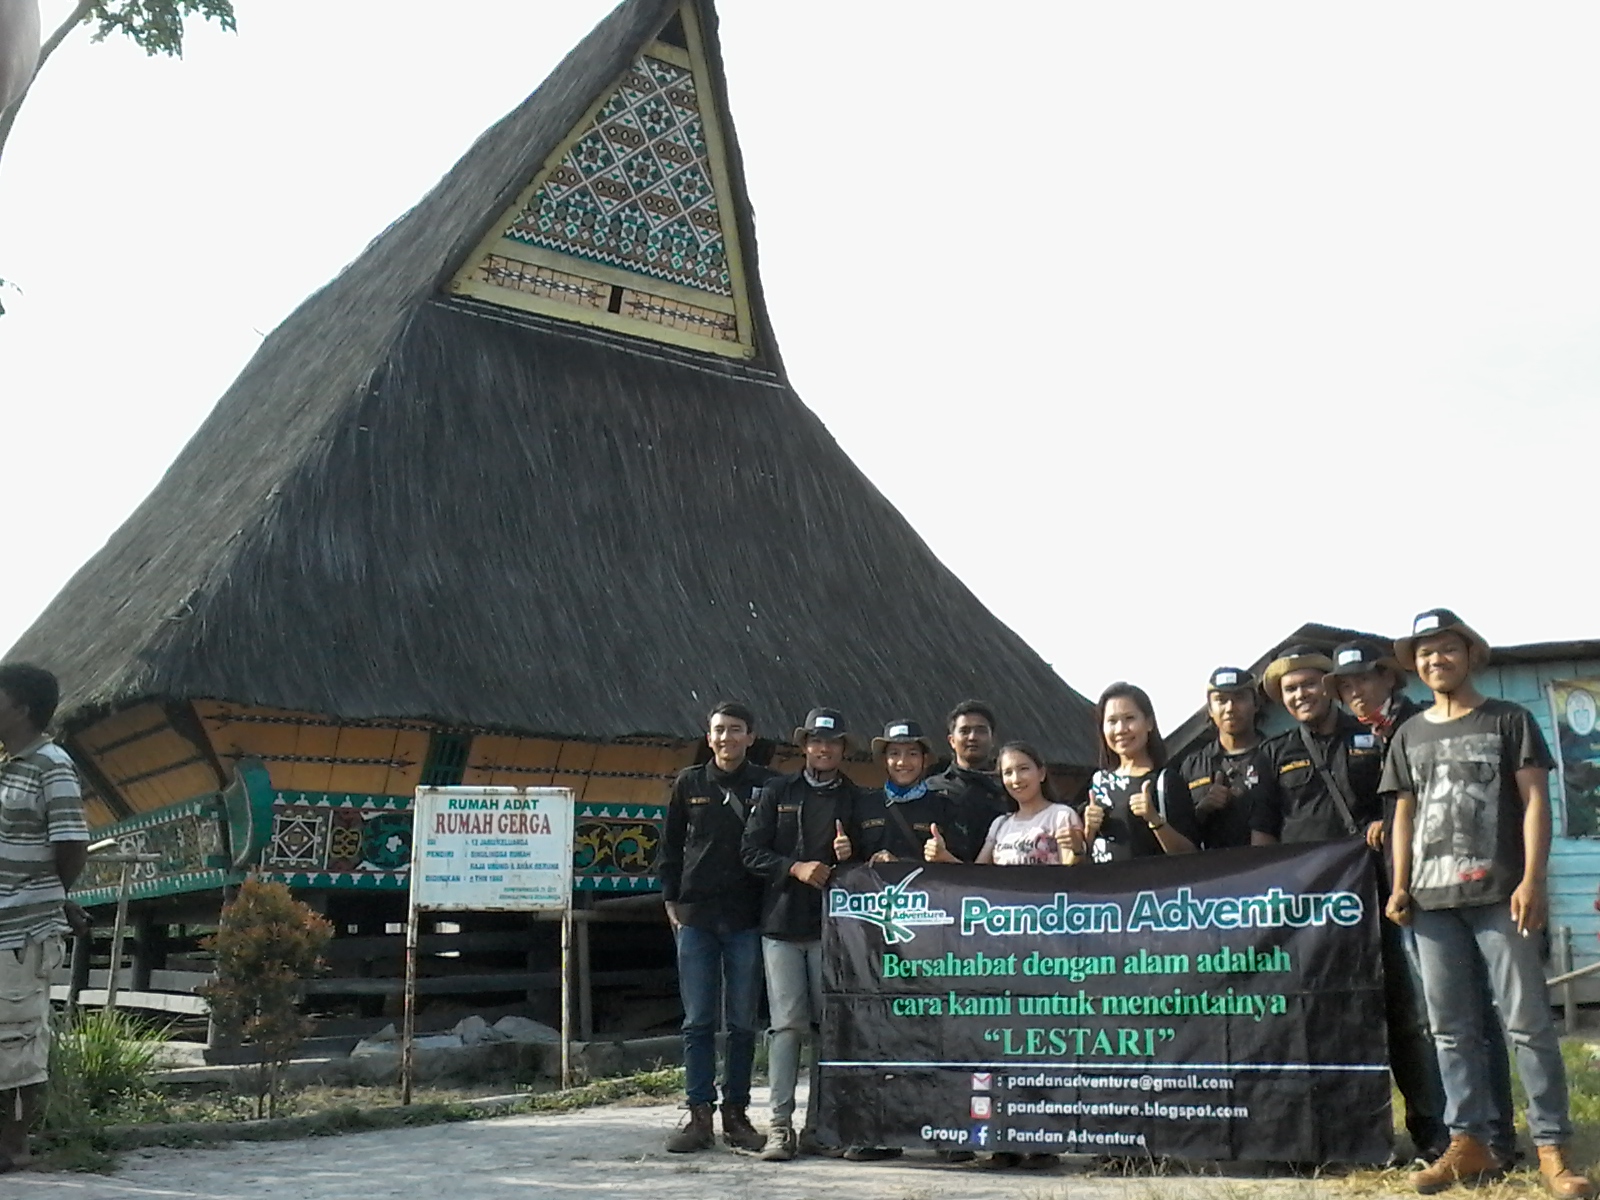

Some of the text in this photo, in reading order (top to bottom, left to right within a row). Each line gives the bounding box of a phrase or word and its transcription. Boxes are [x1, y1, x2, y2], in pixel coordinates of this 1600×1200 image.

[449, 799, 540, 811] RUMAH ADAT
[435, 813, 552, 835] RUMAH GERGA
[830, 886, 929, 913] Pandan
[960, 886, 1364, 936] Pandan Adventure
[882, 945, 1292, 983] Bersahabat dengan alam adalah
[892, 986, 1288, 1023] cara kami untuk mencintainya
[1007, 1073, 1235, 1092] pandanadventure@gmail.com
[1007, 1101, 1249, 1121] pandanadventure.blogspot.com
[920, 1125, 969, 1145] Group
[1007, 1128, 1064, 1144] Pandan
[1067, 1128, 1146, 1147] Adventure
